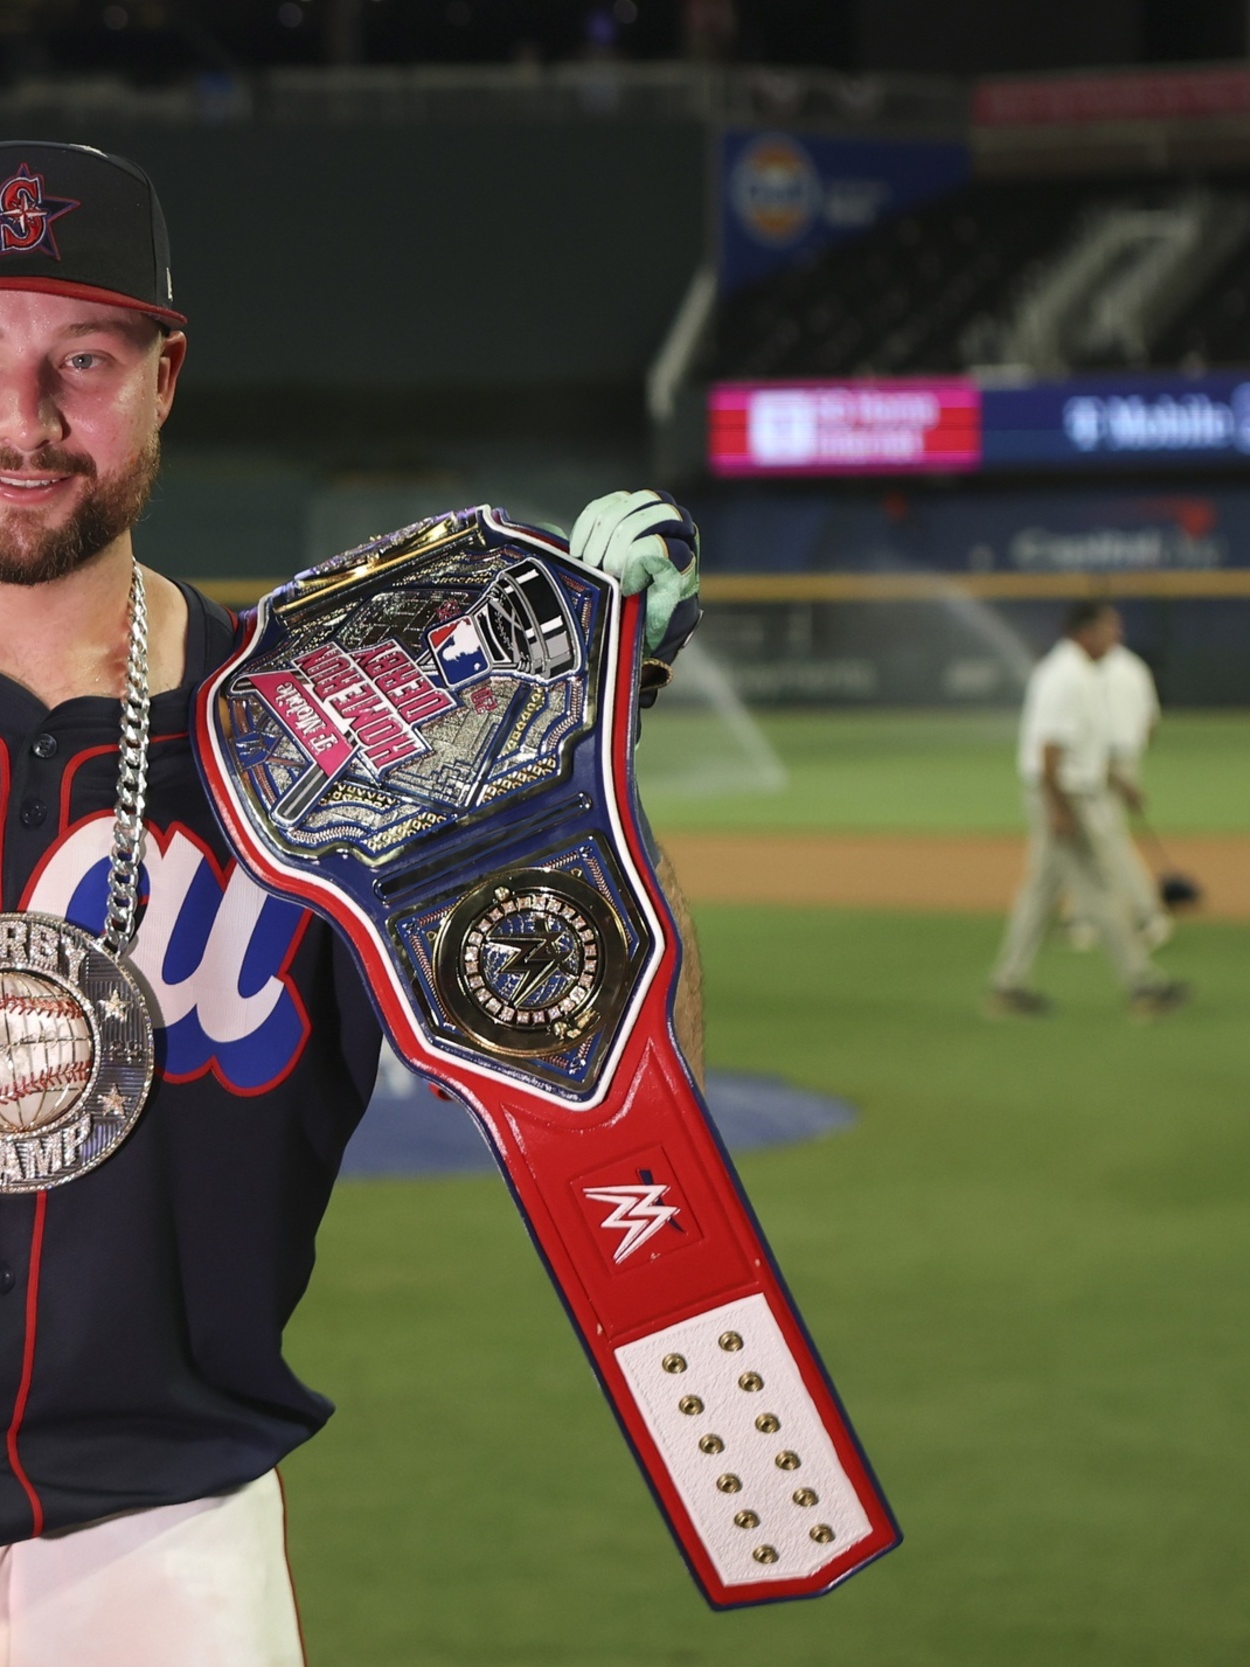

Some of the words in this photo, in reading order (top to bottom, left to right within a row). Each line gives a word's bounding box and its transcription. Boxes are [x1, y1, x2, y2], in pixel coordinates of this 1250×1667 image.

[0, 177, 46, 250] S
[270, 679, 325, 736] Mobile
[293, 640, 361, 702] RUN
[349, 639, 452, 725] DERBY
[329, 680, 419, 770] HOME
